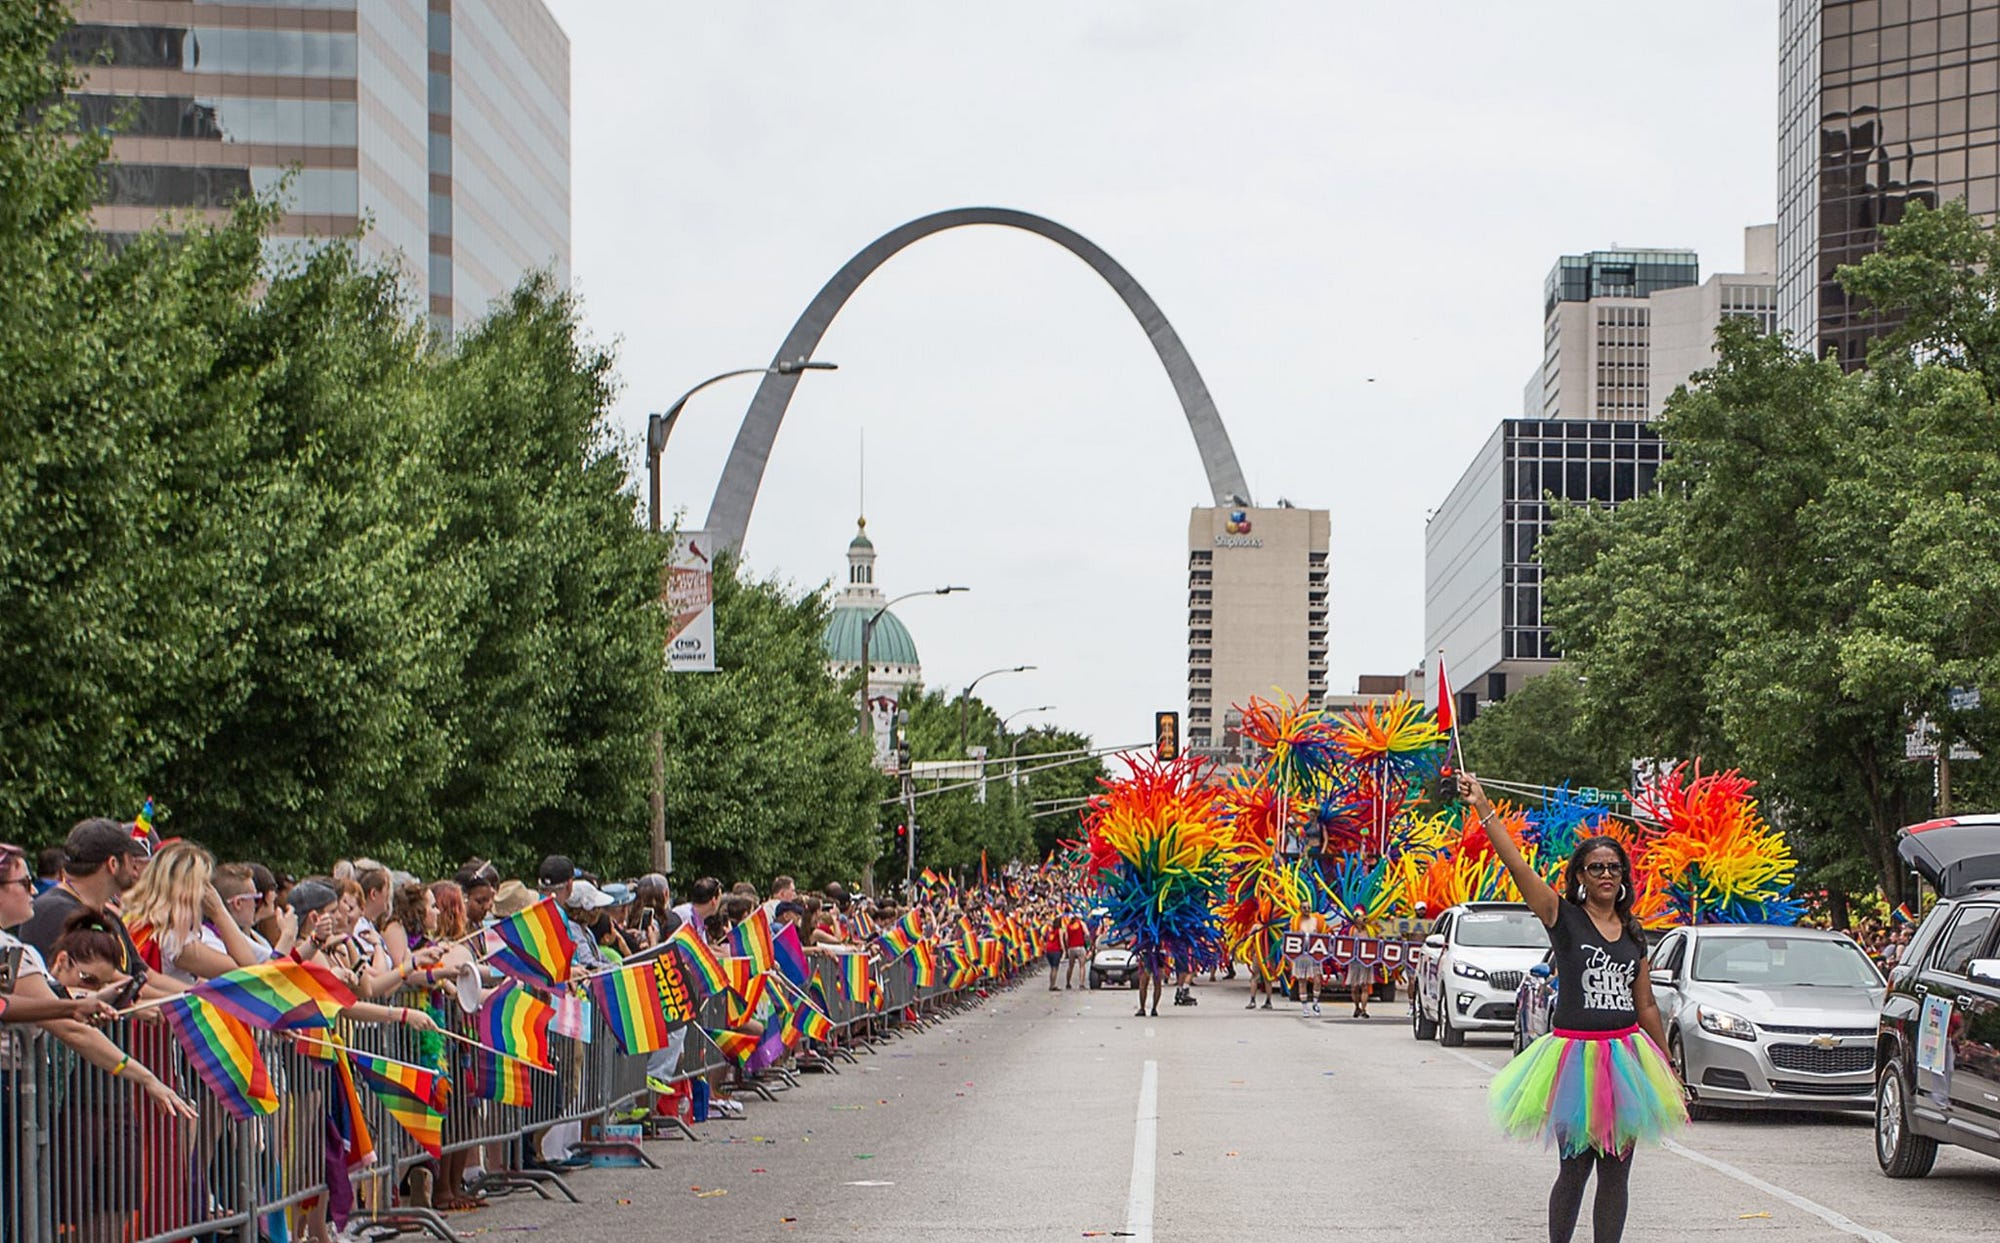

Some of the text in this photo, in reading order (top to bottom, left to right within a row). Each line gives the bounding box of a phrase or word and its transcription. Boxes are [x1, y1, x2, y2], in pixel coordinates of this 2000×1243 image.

[658, 949, 697, 1022] BORN
[1580, 944, 1635, 975] Black
[653, 961, 680, 1023] THIS
